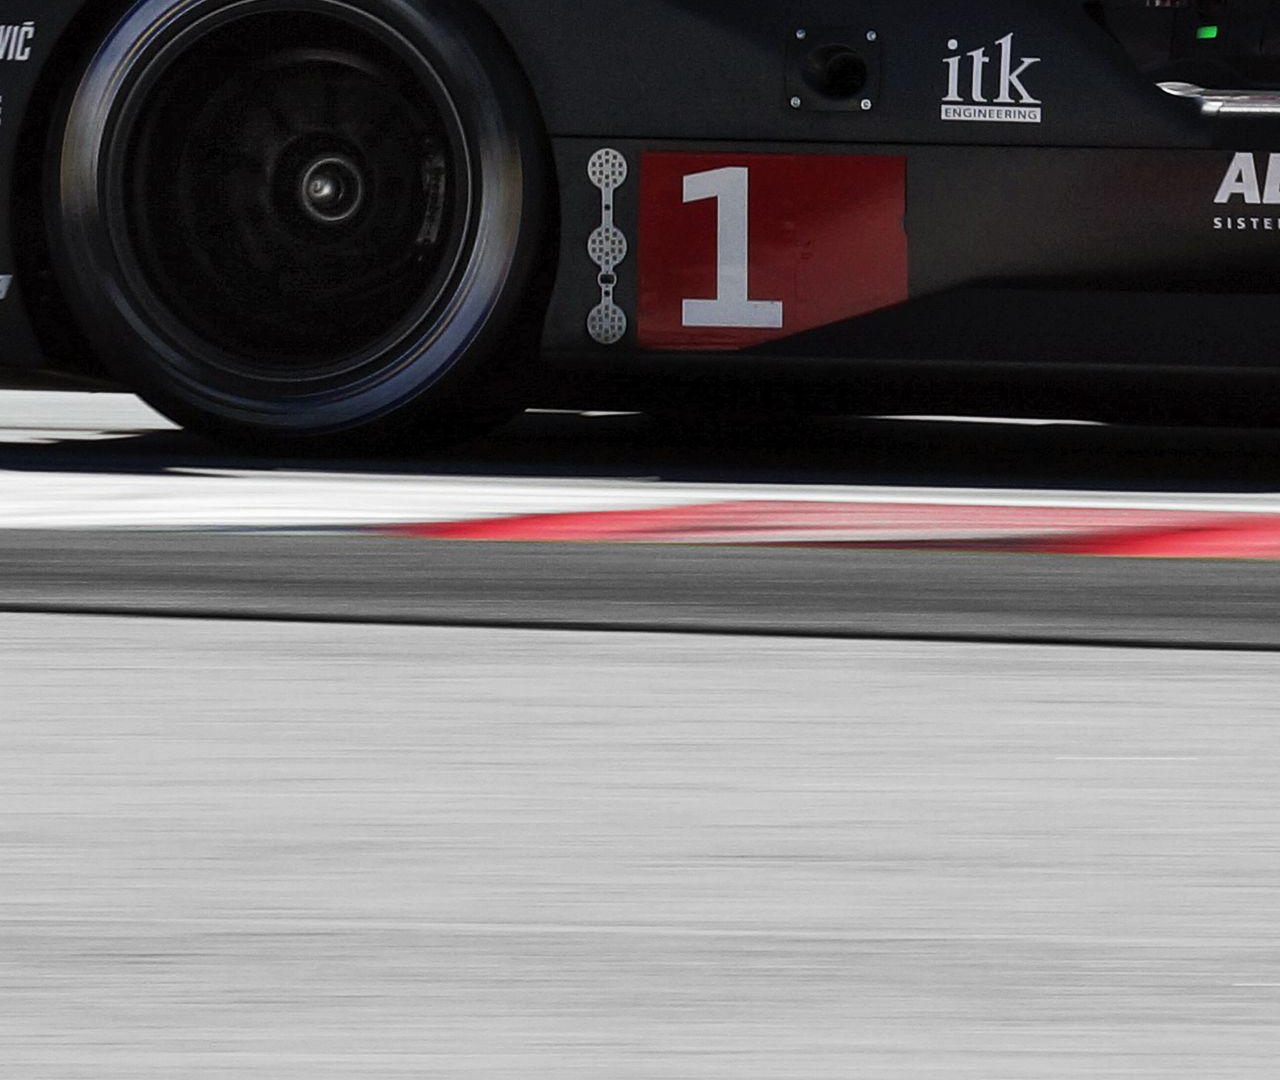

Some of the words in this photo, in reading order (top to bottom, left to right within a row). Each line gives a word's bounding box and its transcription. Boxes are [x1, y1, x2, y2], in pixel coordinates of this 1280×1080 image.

[941, 32, 1042, 104] itk
[944, 107, 1038, 121] ENGINEERING
[682, 166, 783, 329] 1
